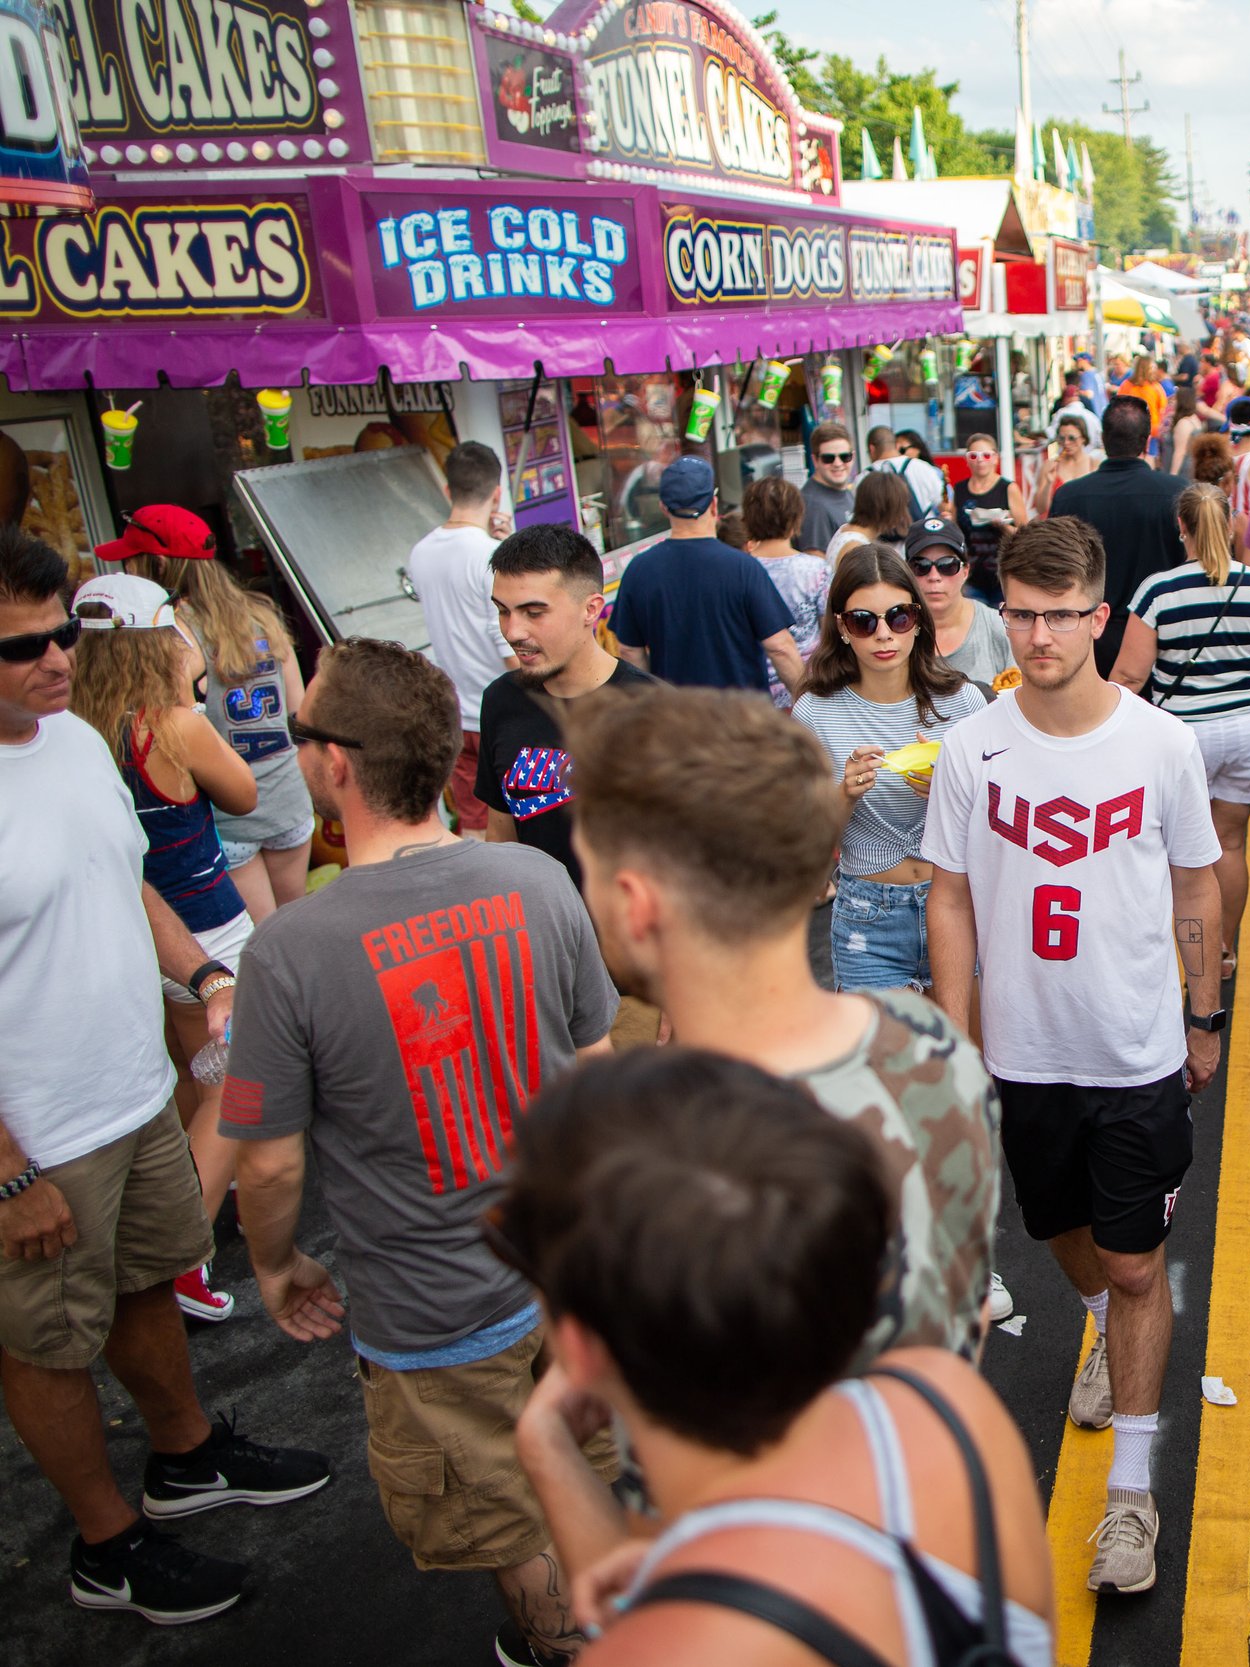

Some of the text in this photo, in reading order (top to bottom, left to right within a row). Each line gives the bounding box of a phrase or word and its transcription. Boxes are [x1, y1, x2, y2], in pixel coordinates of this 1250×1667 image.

[122, 0, 313, 122] CAKES
[532, 66, 563, 97] Fruit
[689, 9, 755, 82] FAMOUS
[590, 50, 790, 179] FUNNEL CAKES
[45, 218, 300, 302] CAKES
[377, 205, 627, 268] ICE COLD
[668, 228, 845, 291] CORN DOGS
[850, 239, 955, 291] FUNNEL CAKES
[408, 252, 616, 309] DRINKS
[309, 384, 388, 416] FUNNEL
[987, 780, 1146, 868] USA
[361, 891, 526, 971] FREEDOM
[1031, 883, 1082, 962] 6
